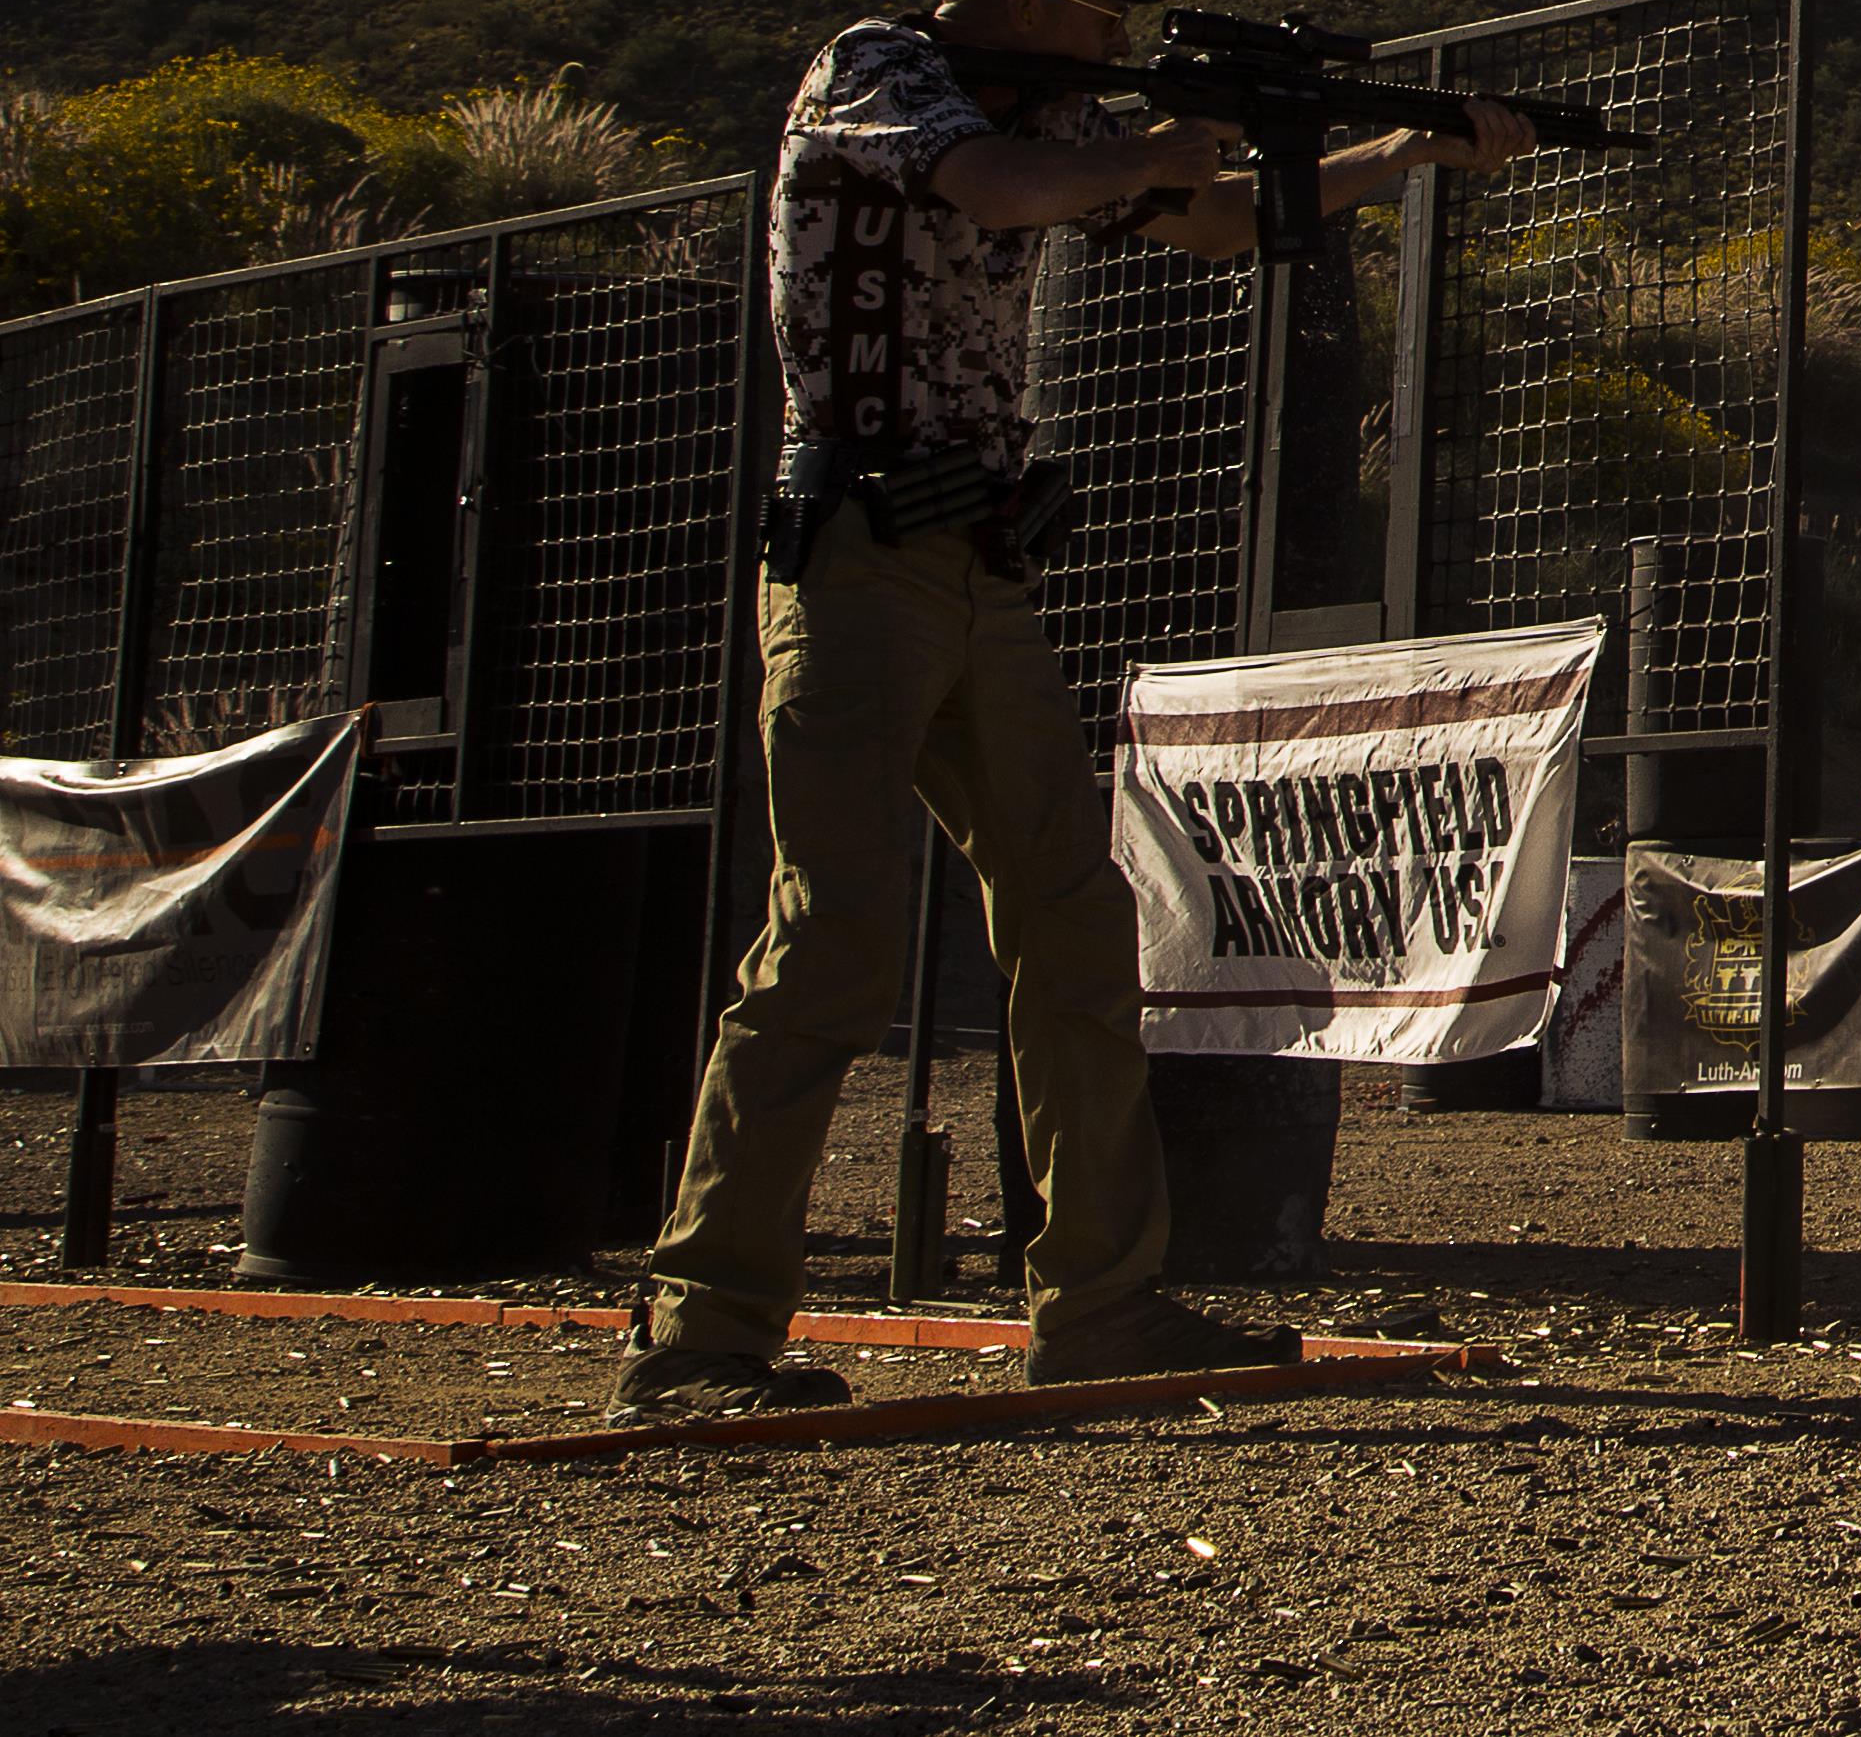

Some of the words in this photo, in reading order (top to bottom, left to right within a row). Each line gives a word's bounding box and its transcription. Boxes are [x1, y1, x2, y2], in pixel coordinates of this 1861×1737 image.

[848, 206, 897, 438] USMC
[1182, 756, 1513, 866] SPRINGFIELD
[1208, 869, 1408, 960] ARMORY
